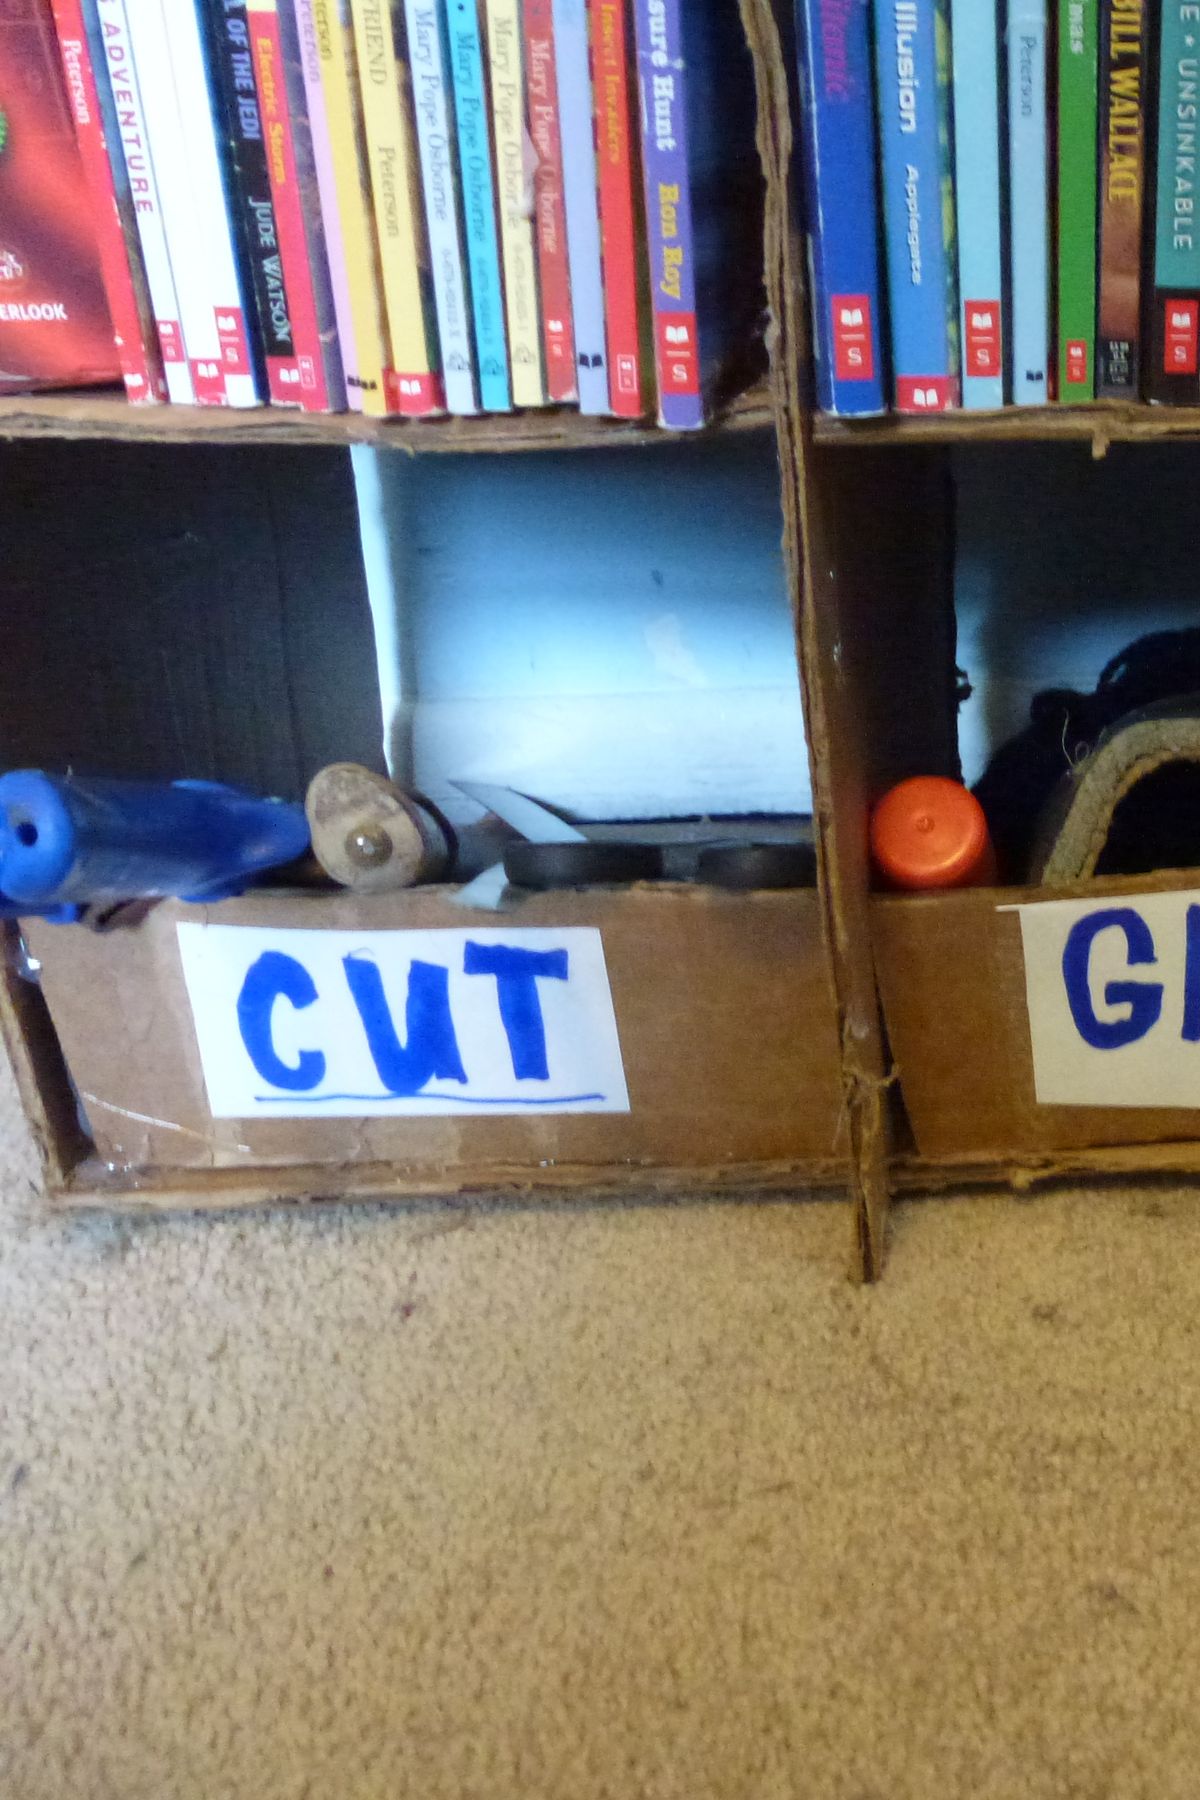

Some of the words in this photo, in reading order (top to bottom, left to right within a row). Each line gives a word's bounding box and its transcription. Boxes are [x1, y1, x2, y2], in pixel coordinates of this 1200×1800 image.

[226, 18, 249, 49] OF
[413, 8, 435, 67] Mary
[455, 31, 476, 90] Mary
[491, 17, 514, 76] Mary
[63, 39, 91, 125] Peterson
[231, 52, 255, 92] THE
[528, 38, 551, 99] Mary
[1019, 35, 1037, 118] Peterson
[103, 21, 154, 213] ADVENTURE
[237, 95, 262, 140] JEDI
[361, 0, 389, 85] RIEND
[378, 145, 400, 238] Peterson
[419, 74, 441, 128] Pope
[459, 96, 481, 149] Pope
[495, 82, 517, 136] Pope
[652, 74, 678, 151] Hunt
[1108, 66, 1141, 204] WALLACE
[1173, 58, 1200, 252] UNSINKABLE
[427, 134, 449, 221] Osborne
[467, 155, 488, 243] Osborne
[248, 195, 277, 248] JUDE
[658, 182, 682, 239] Ron
[904, 163, 923, 288] Applegate
[261, 254, 293, 343] WATSON
[659, 246, 683, 300] Roy
